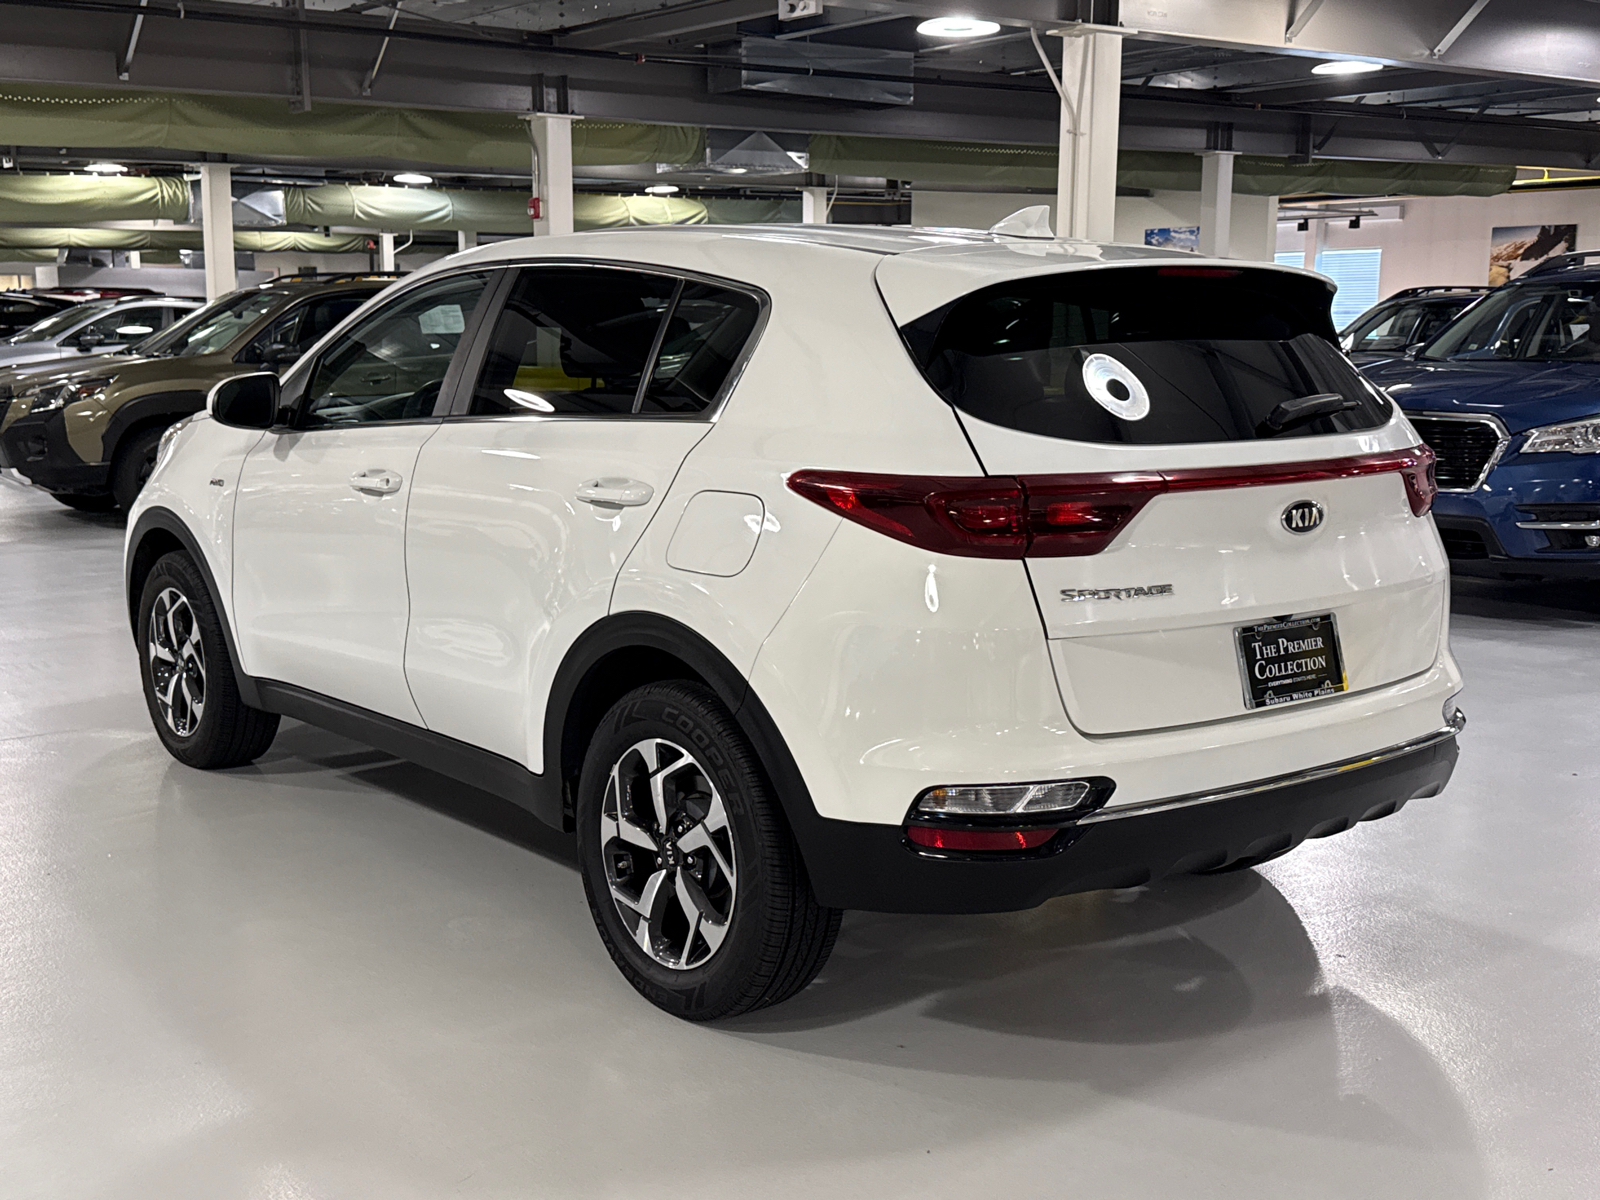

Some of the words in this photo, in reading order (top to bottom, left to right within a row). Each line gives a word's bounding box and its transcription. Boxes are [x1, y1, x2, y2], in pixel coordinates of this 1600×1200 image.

[1291, 507, 1320, 528] KIA
[1060, 584, 1175, 602] SPORTAGE
[1252, 642, 1278, 659] THE
[1278, 637, 1323, 655] PREMIER
[1254, 656, 1326, 679] COLLECTION
[1265, 695, 1291, 705] Subaru
[1292, 691, 1313, 701] White
[1314, 688, 1335, 697] Plains
[661, 706, 745, 816] COOPER
[665, 841, 675, 865] KIA
